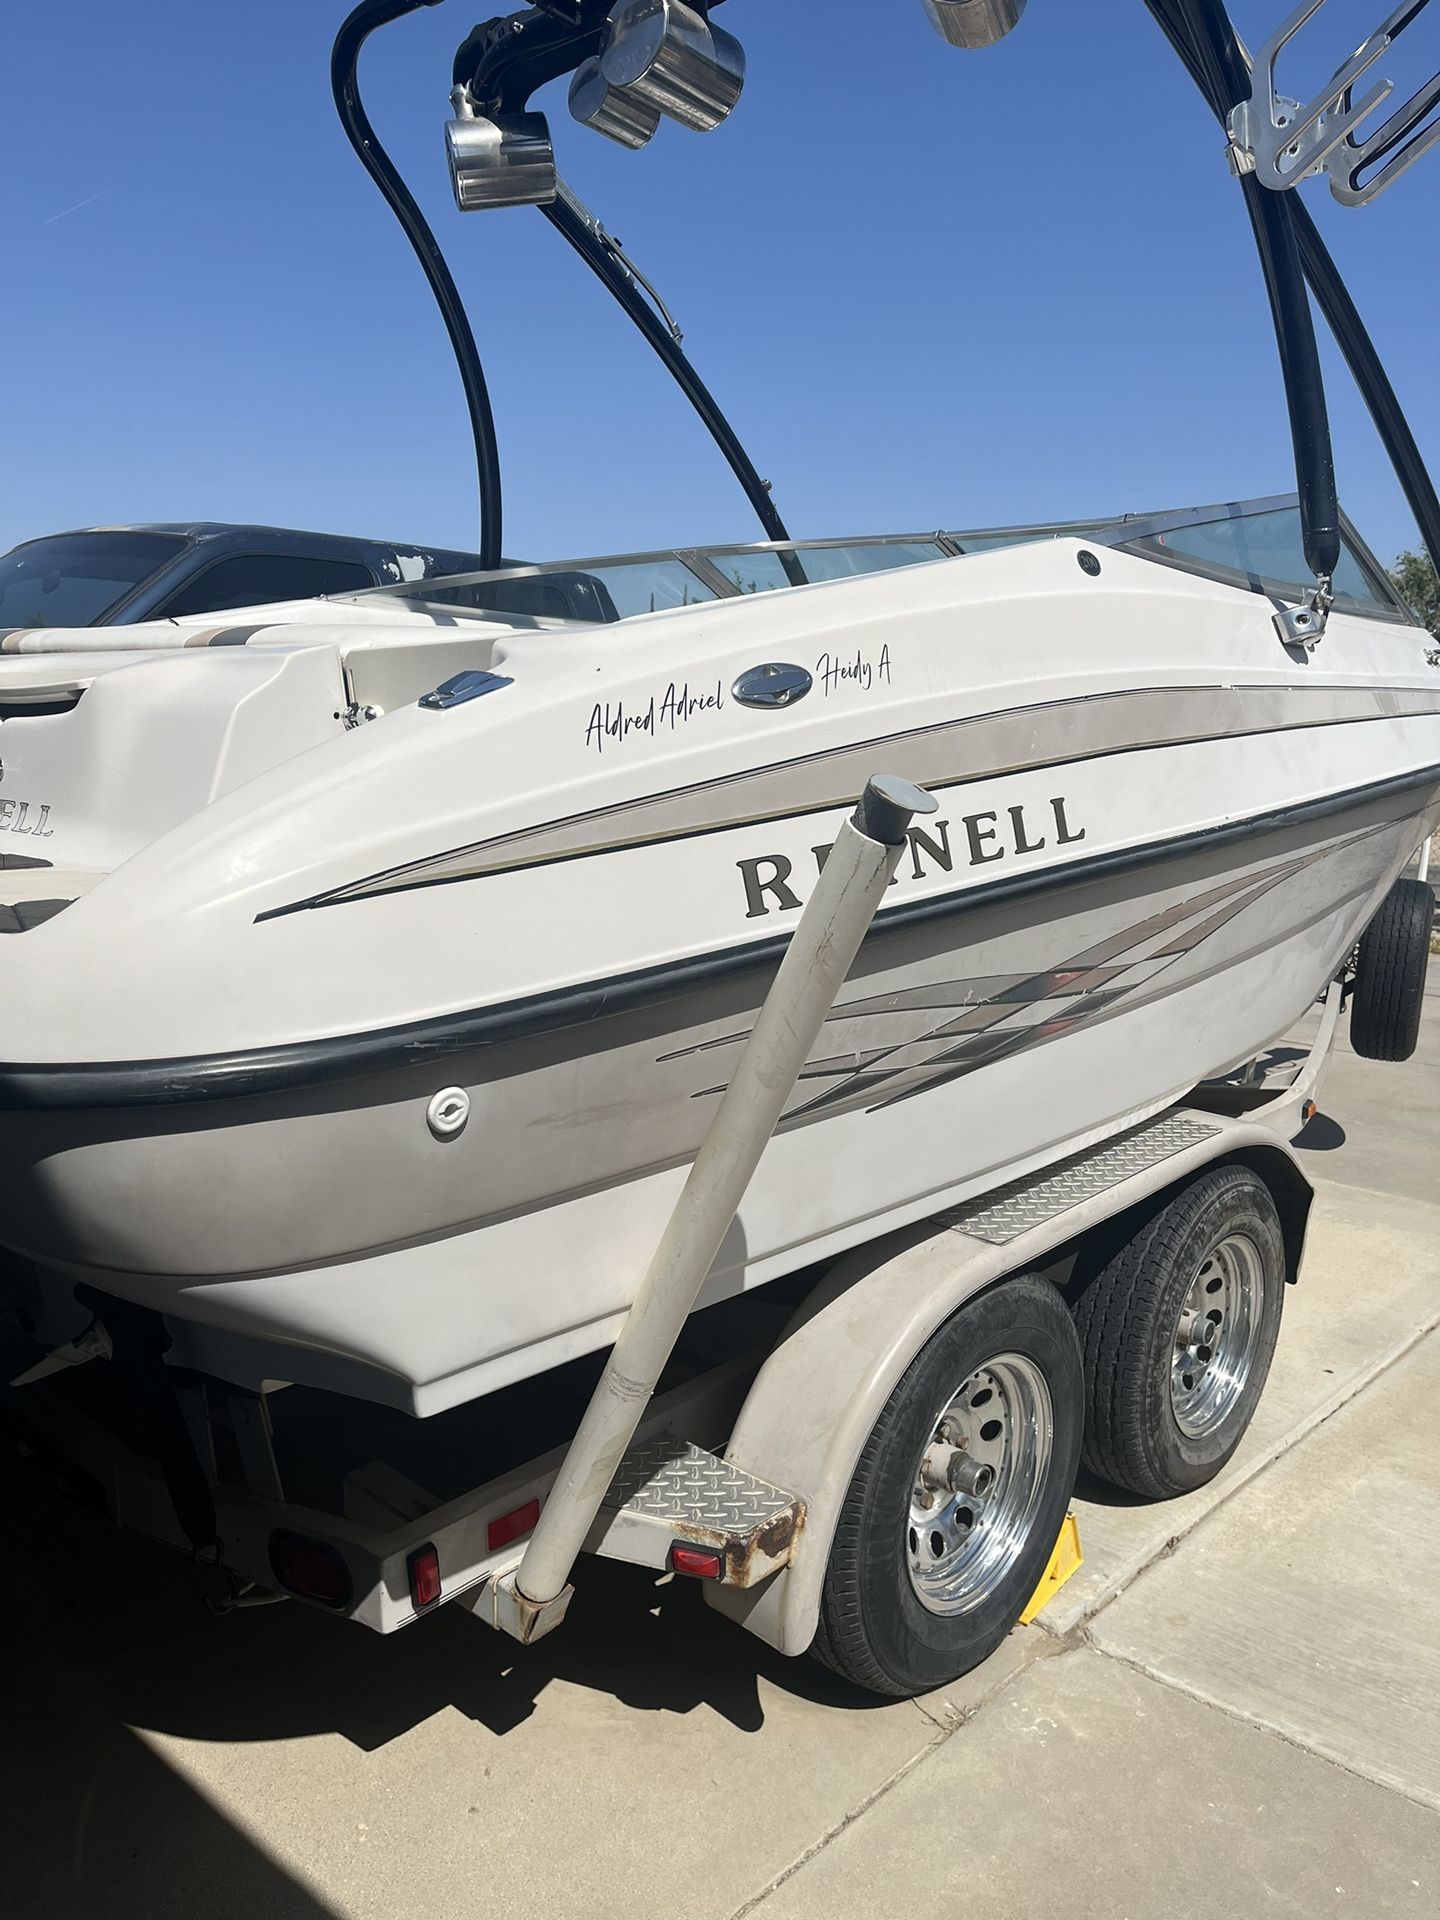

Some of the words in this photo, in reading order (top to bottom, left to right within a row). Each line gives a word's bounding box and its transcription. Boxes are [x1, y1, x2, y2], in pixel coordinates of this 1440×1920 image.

[816, 650, 873, 697] Heidy
[878, 643, 892, 685] A
[585, 696, 654, 753] Aldred
[660, 680, 724, 730] Adriel
[736, 797, 1085, 918] RNELL
